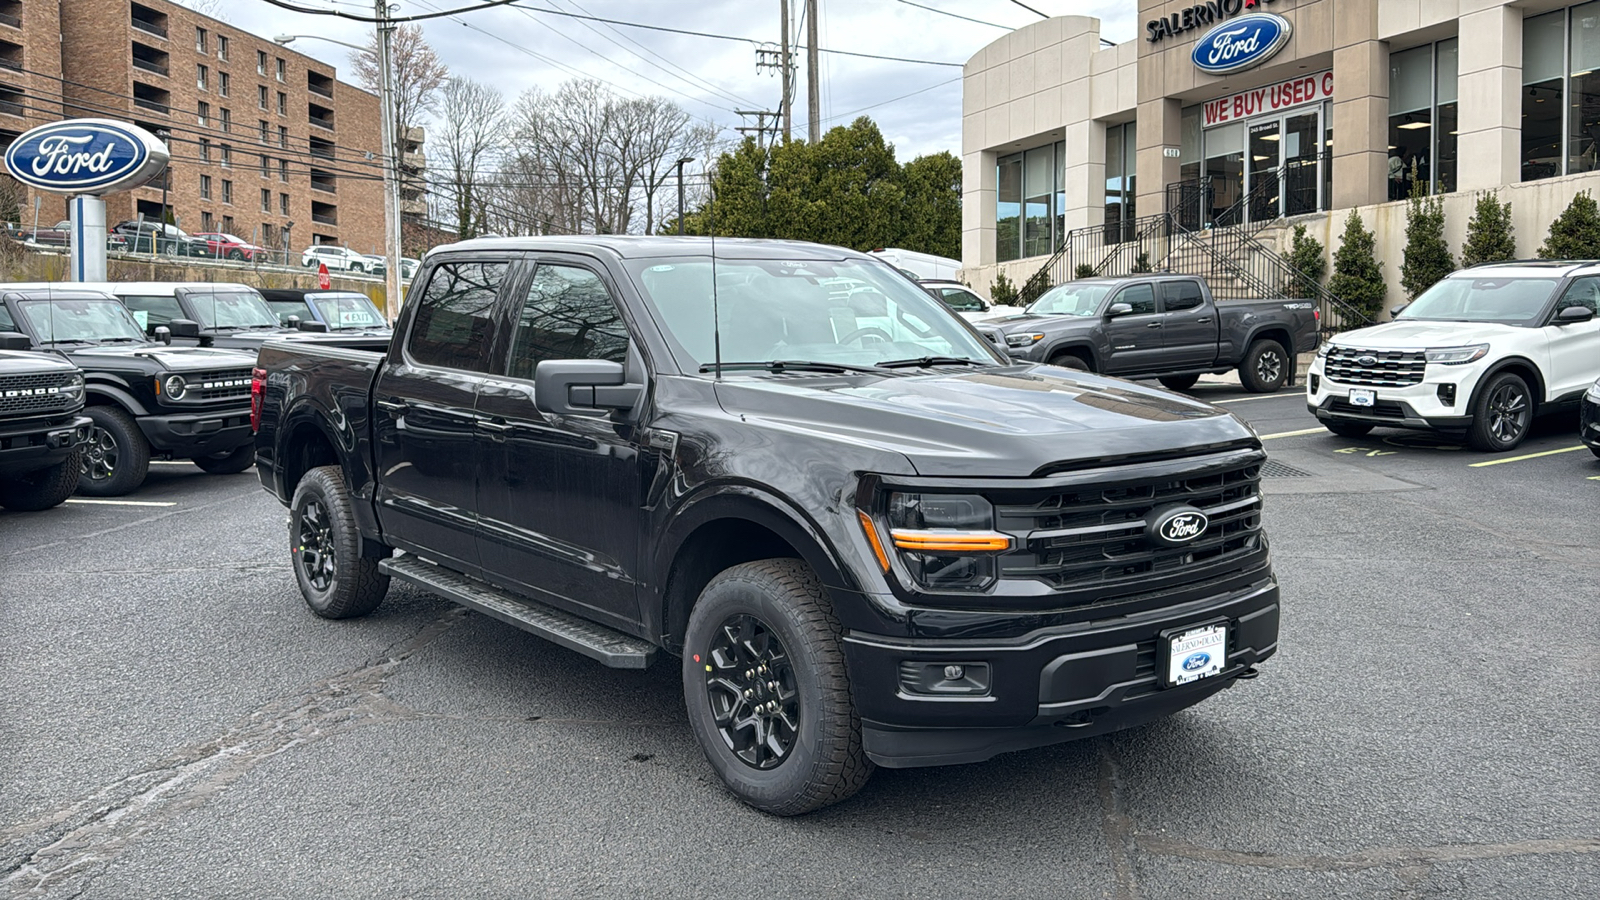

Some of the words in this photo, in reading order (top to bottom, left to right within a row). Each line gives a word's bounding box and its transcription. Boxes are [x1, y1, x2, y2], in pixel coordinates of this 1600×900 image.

[1146, 0, 1242, 42] SALERNO
[1208, 26, 1261, 64] Ford
[1205, 99, 1229, 125] WE
[1233, 88, 1266, 118] BUY
[1270, 77, 1316, 109] USED
[32, 134, 116, 177] Ford
[351, 313, 369, 321] EXIT
[0, 387, 59, 397] ONCO
[1170, 516, 1200, 538] Ford
[1172, 640, 1200, 653] SALERNO
[1201, 633, 1222, 645] DUANE
[1186, 655, 1206, 670] Ford
